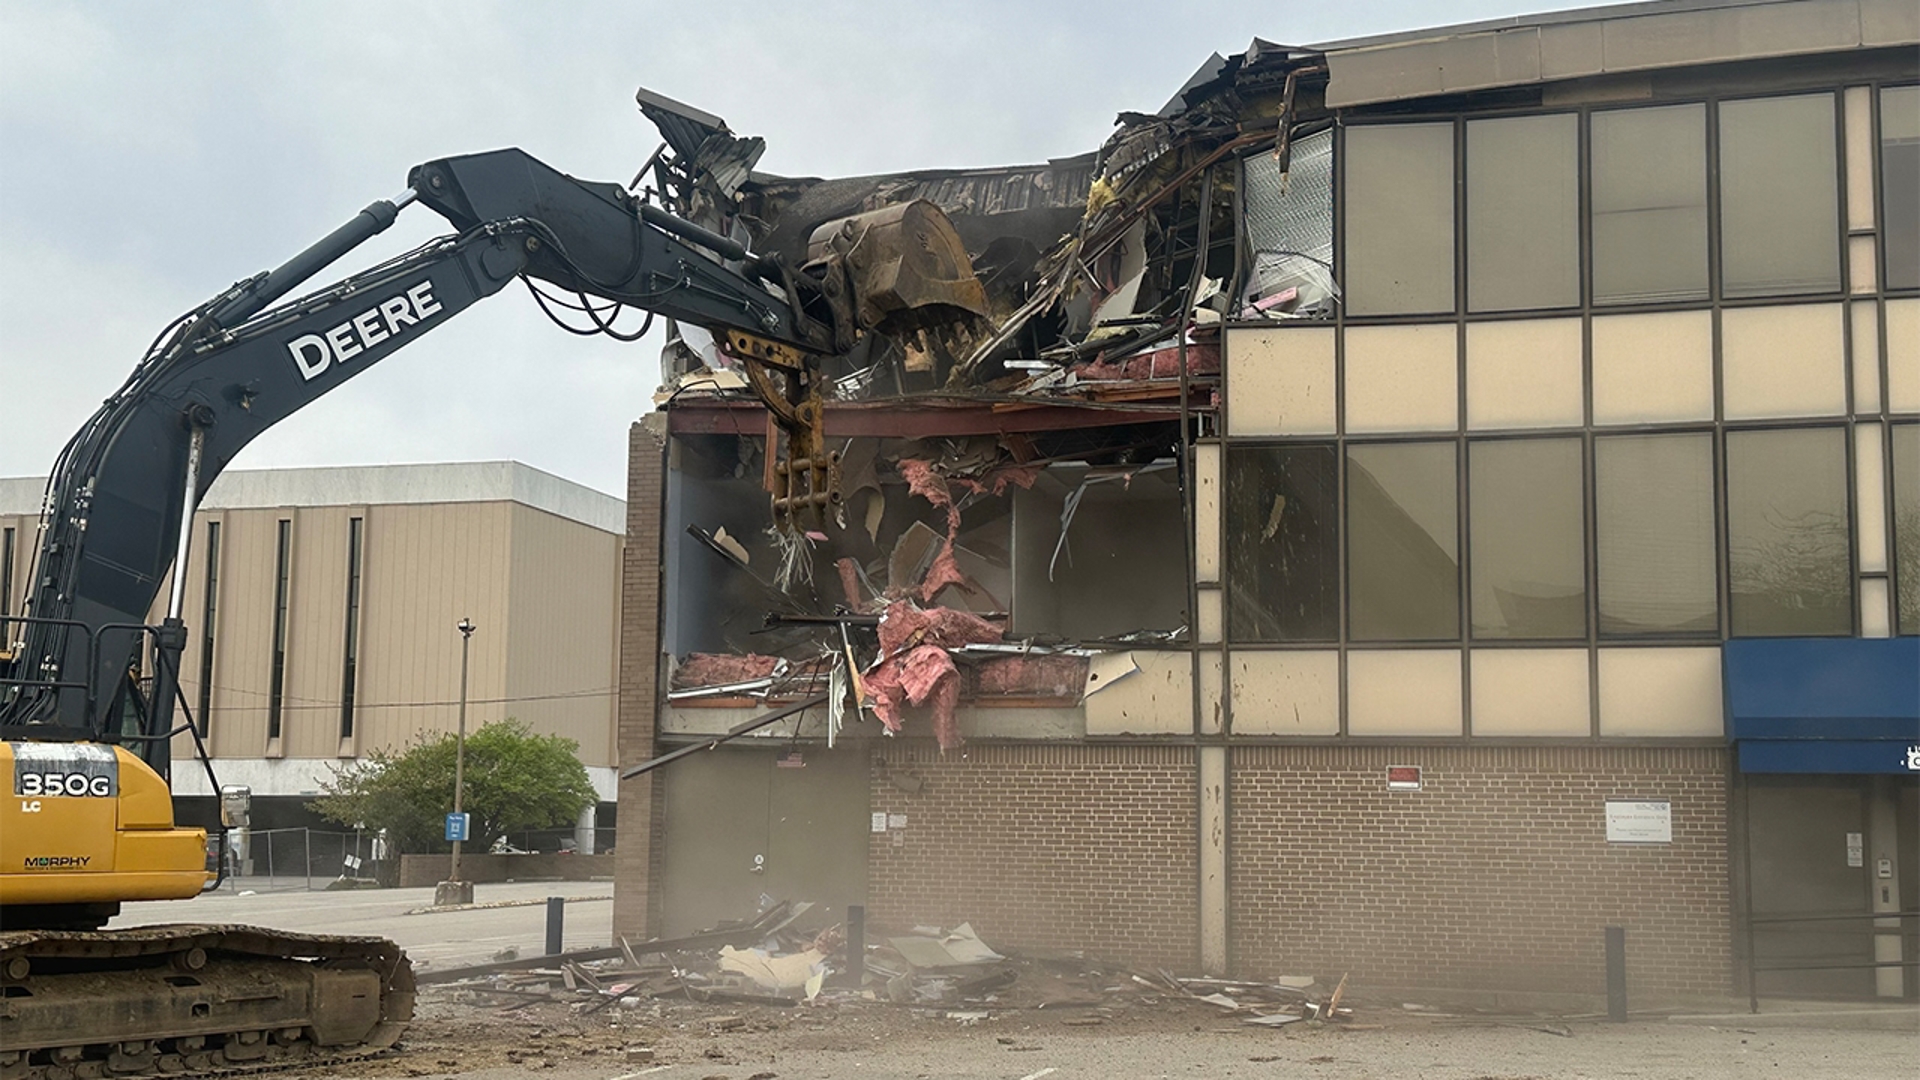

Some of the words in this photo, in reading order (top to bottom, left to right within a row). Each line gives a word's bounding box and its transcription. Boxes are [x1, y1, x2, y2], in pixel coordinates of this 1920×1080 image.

[287, 280, 443, 381] DEERE
[22, 773, 109, 796] 350G
[21, 801, 41, 813] LC
[24, 856, 91, 866] MURPHY
